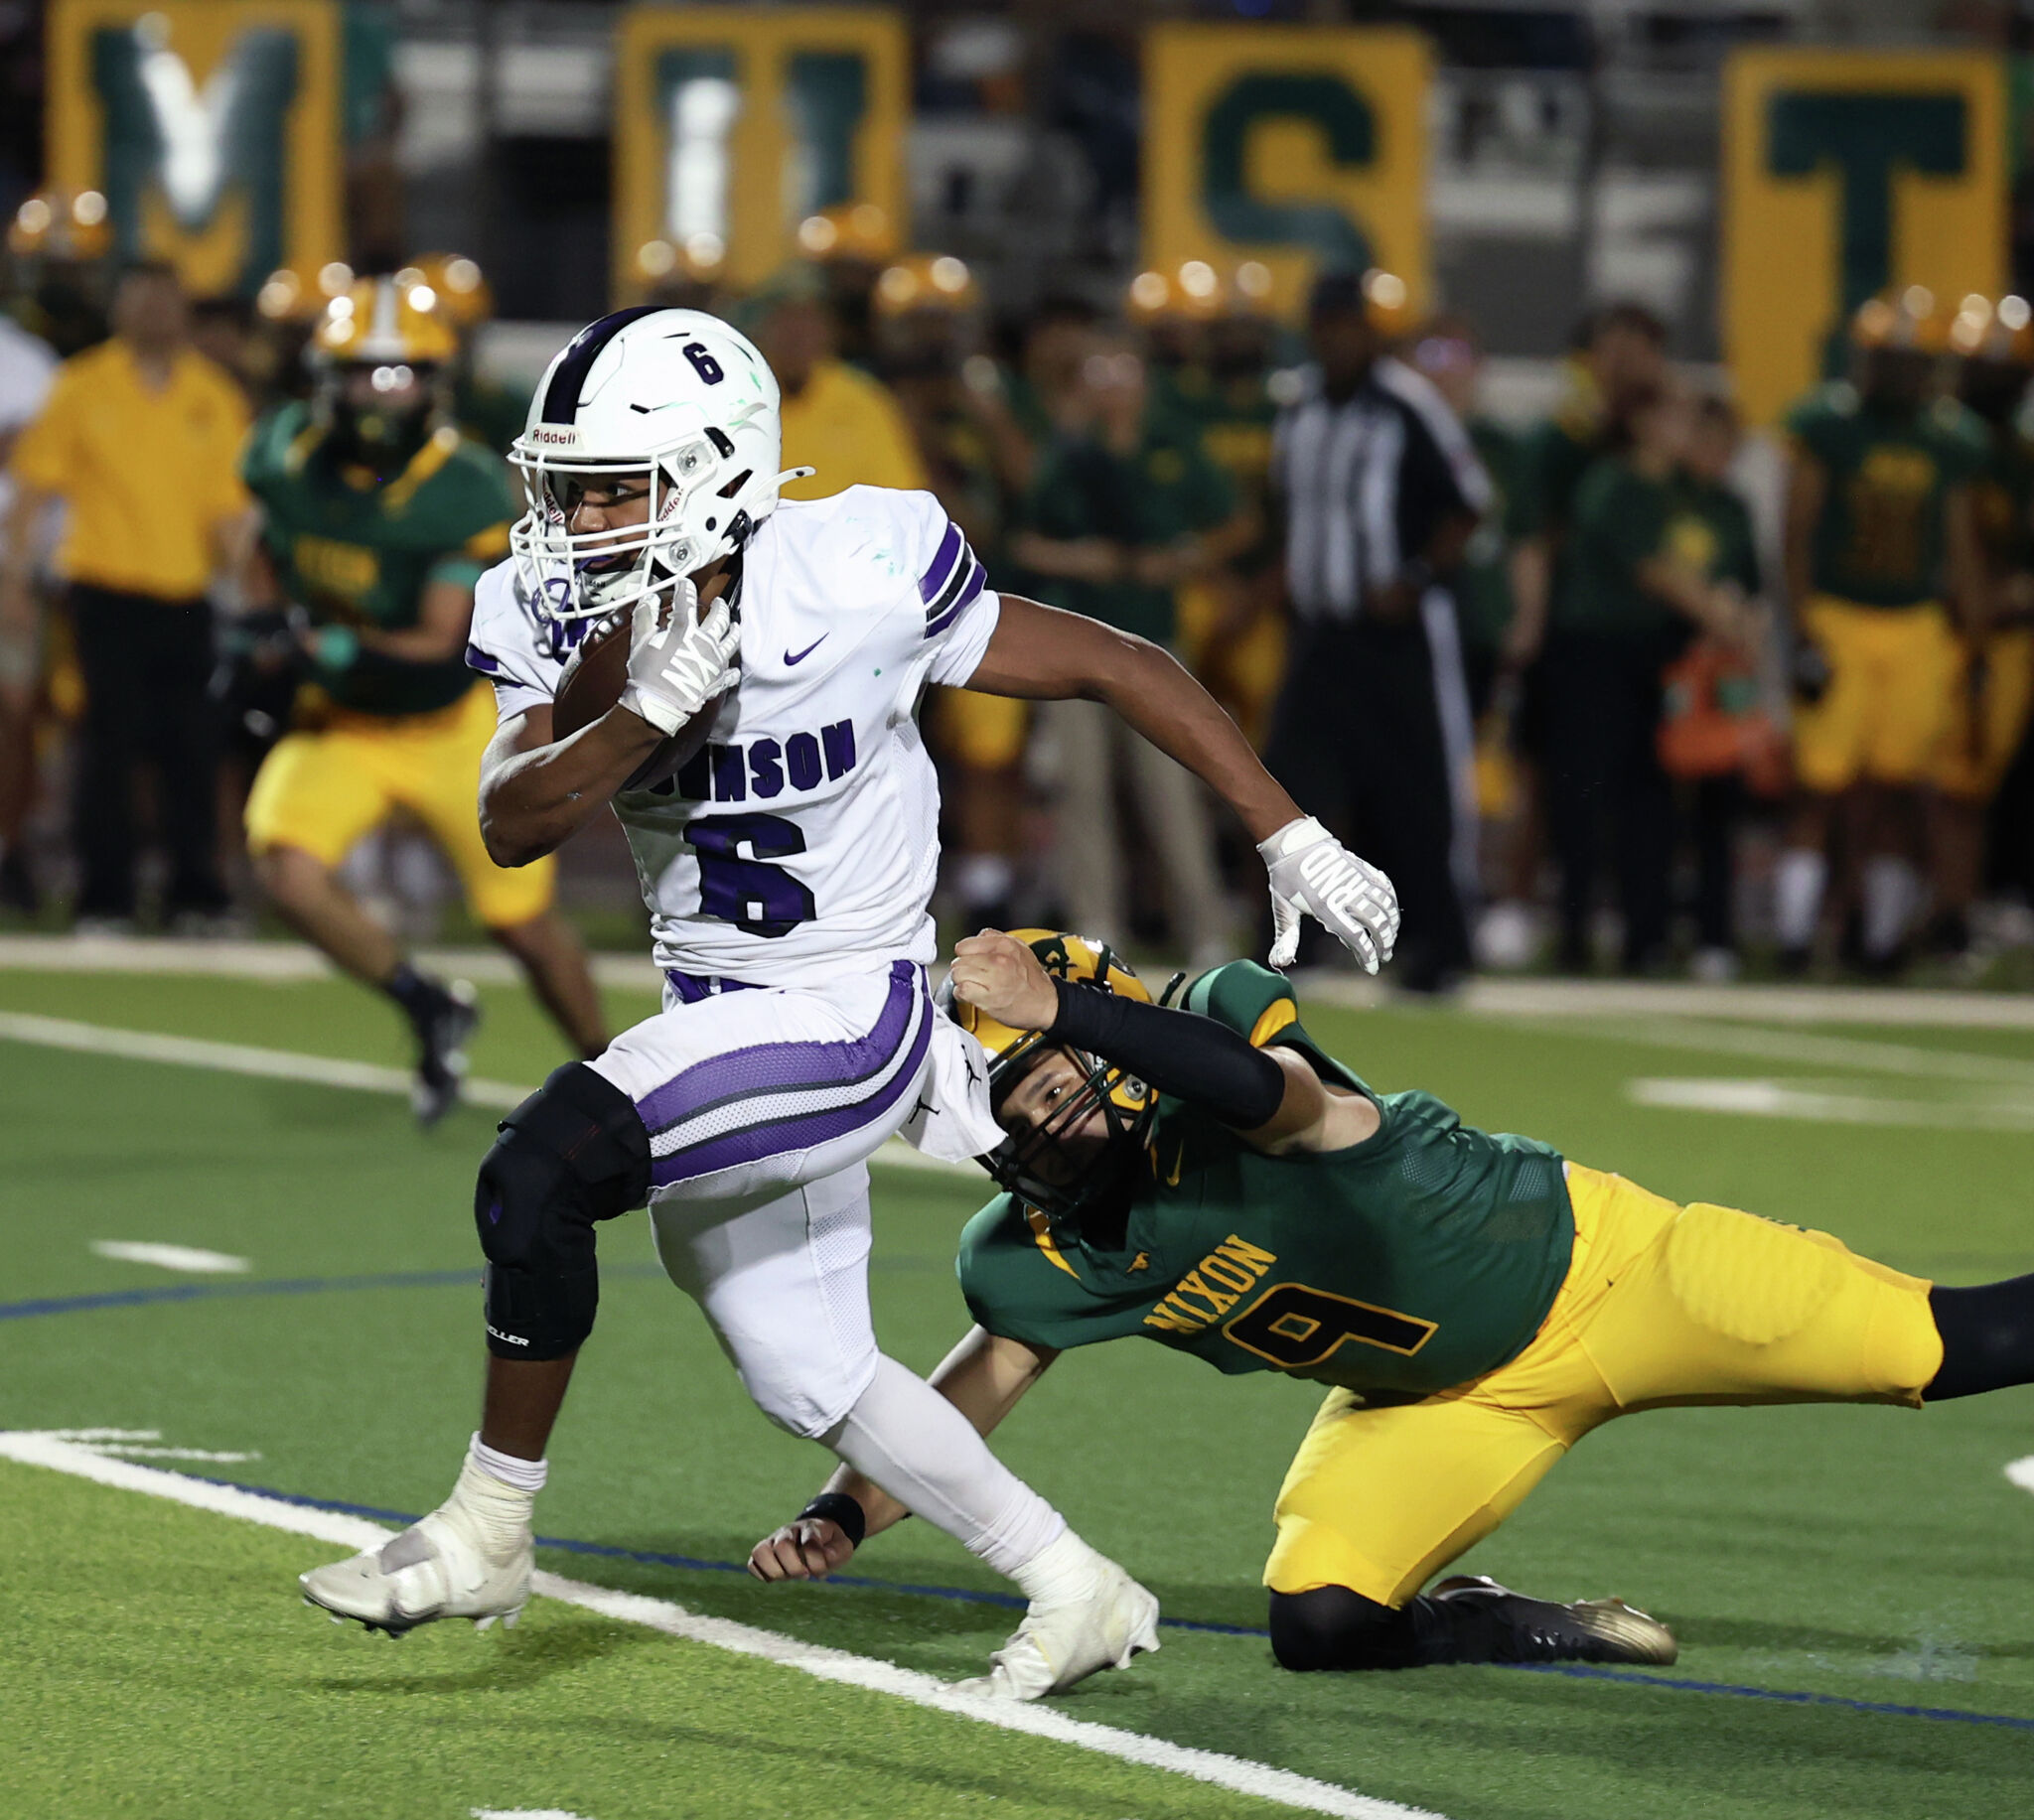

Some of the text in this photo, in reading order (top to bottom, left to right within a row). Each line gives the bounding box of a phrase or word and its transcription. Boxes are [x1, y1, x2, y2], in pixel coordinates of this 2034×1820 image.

[682, 342, 724, 385] 6
[532, 428, 576, 445] Riddell
[683, 813, 816, 938] 6
[1143, 1233, 1278, 1333] NIXON
[1222, 1282, 1439, 1367] 9
